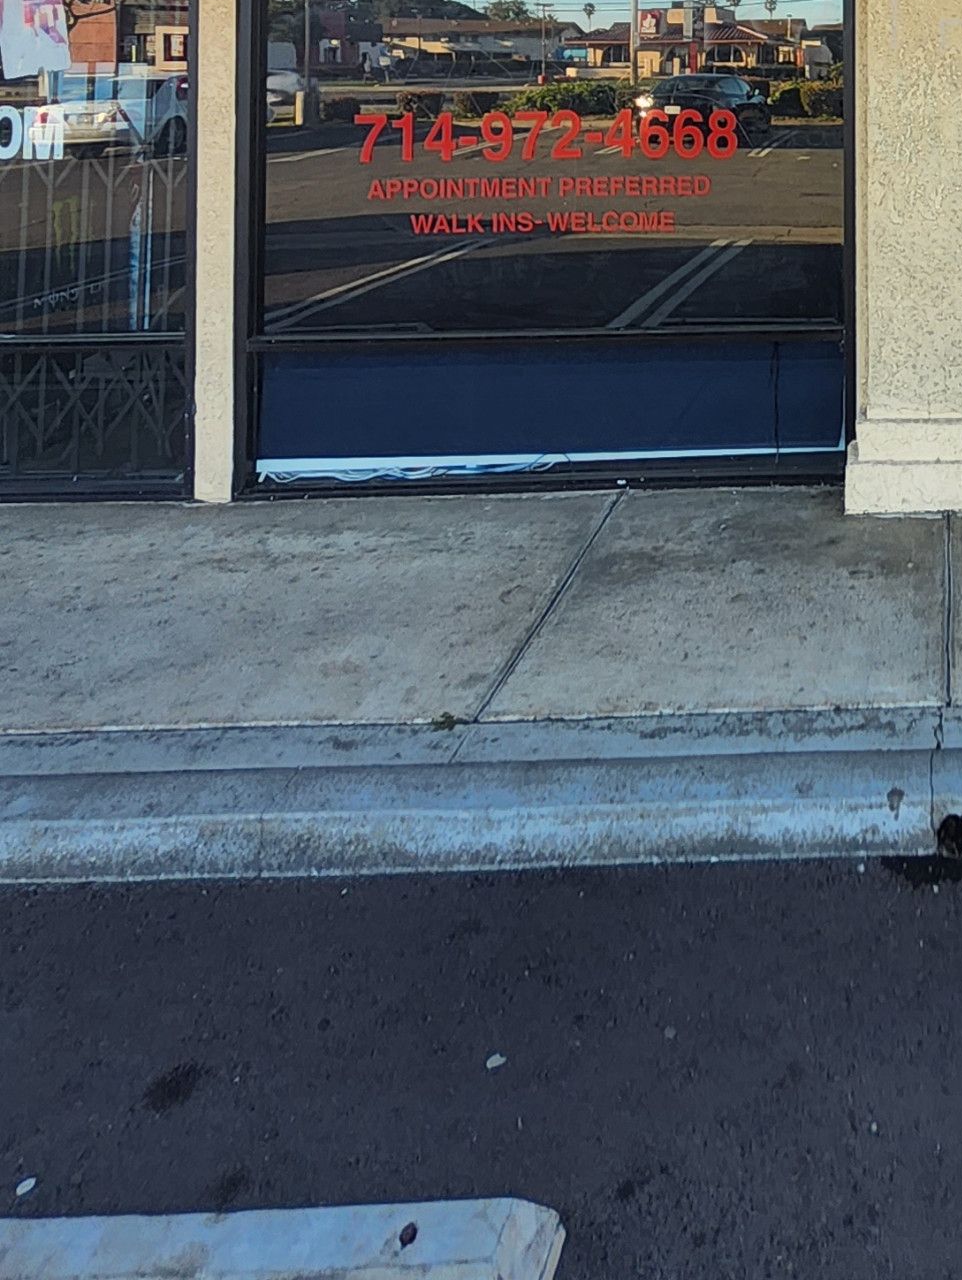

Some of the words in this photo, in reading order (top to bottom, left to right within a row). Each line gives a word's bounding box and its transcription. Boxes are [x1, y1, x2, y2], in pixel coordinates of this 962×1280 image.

[354, 109, 738, 164] 714-972-4668
[368, 177, 552, 200] APPOINTMENT
[559, 175, 712, 198] PREFERRED
[411, 213, 487, 235] WALK
